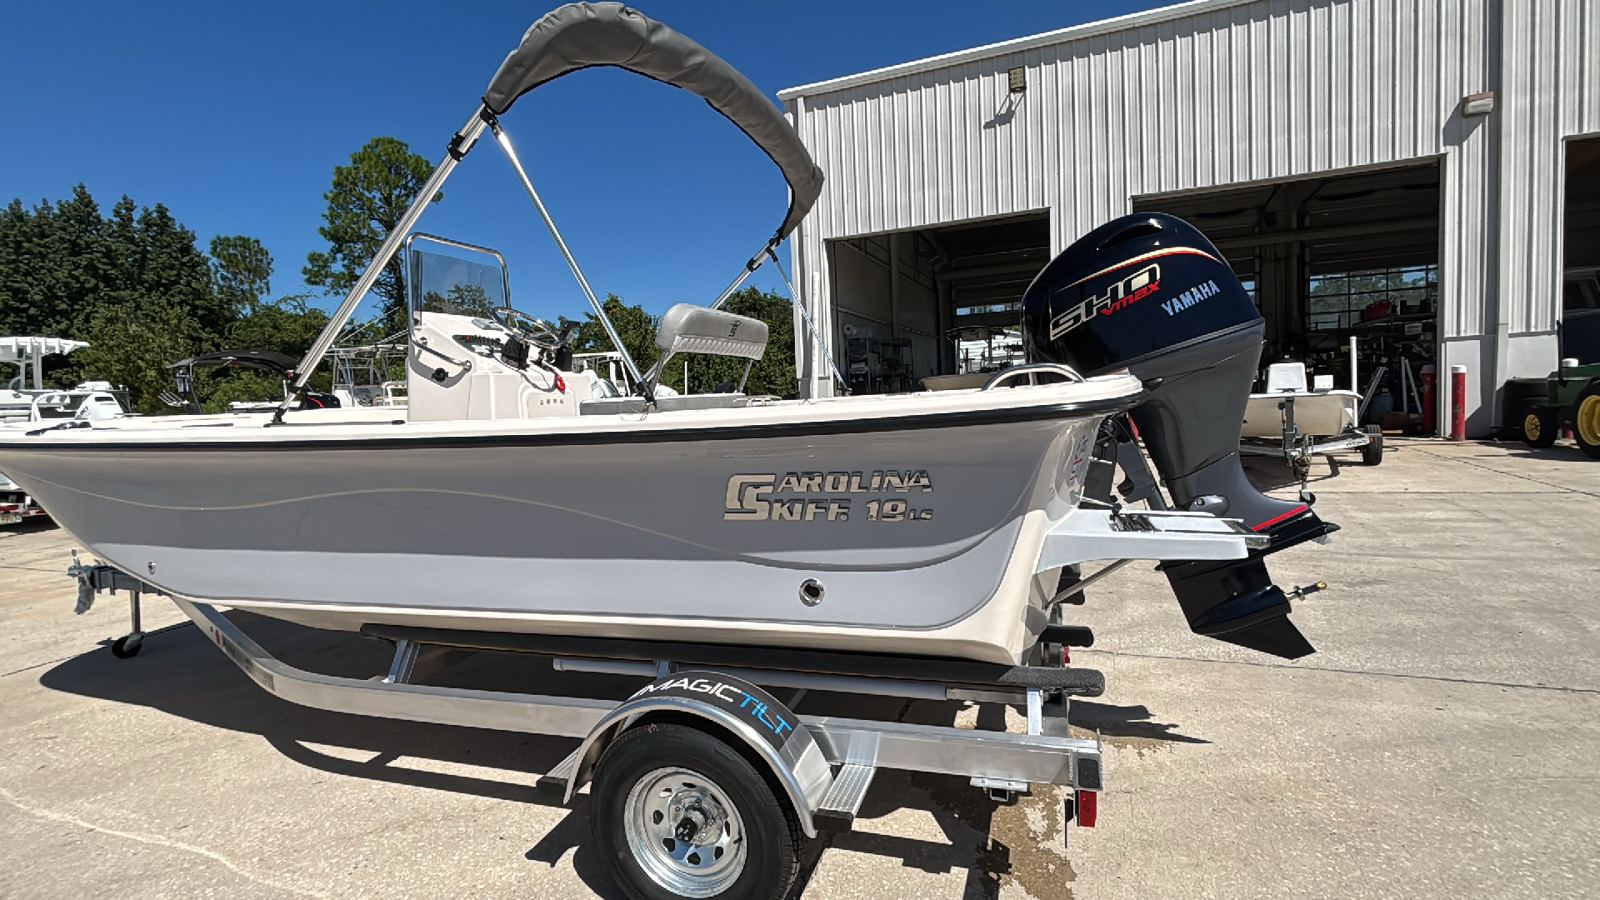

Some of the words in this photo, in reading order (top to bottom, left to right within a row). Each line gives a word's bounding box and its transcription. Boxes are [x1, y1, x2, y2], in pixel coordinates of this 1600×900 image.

[1050, 263, 1160, 341] SHO
[1161, 279, 1221, 316] YAMAHA
[725, 470, 934, 508] CAROLINA
